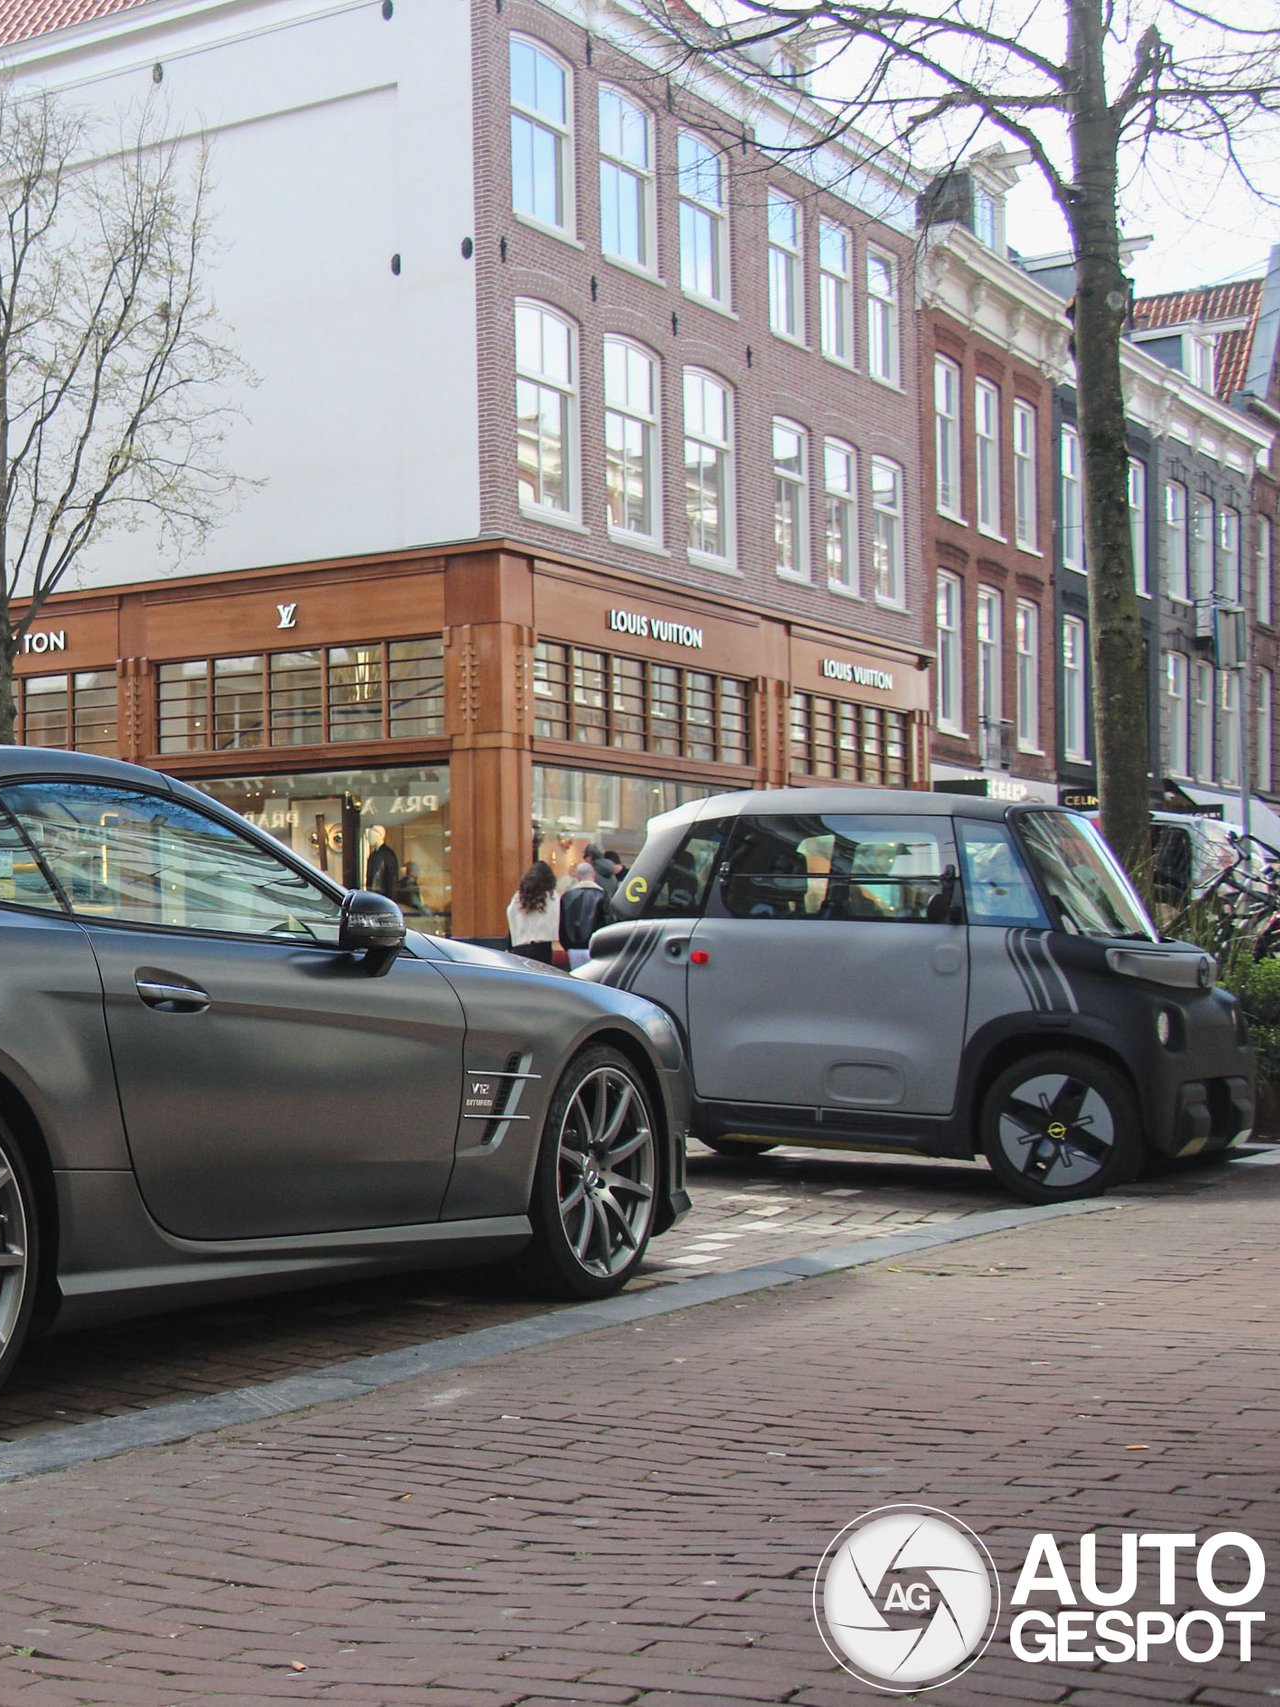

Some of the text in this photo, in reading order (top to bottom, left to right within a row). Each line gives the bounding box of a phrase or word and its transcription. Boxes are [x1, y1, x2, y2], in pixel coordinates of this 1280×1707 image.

[609, 608, 703, 649] LOUIS VUITTON
[823, 658, 893, 691] LOUIS VUITTON
[1064, 795, 1100, 806] CELIN
[471, 1083, 490, 1095] V12
